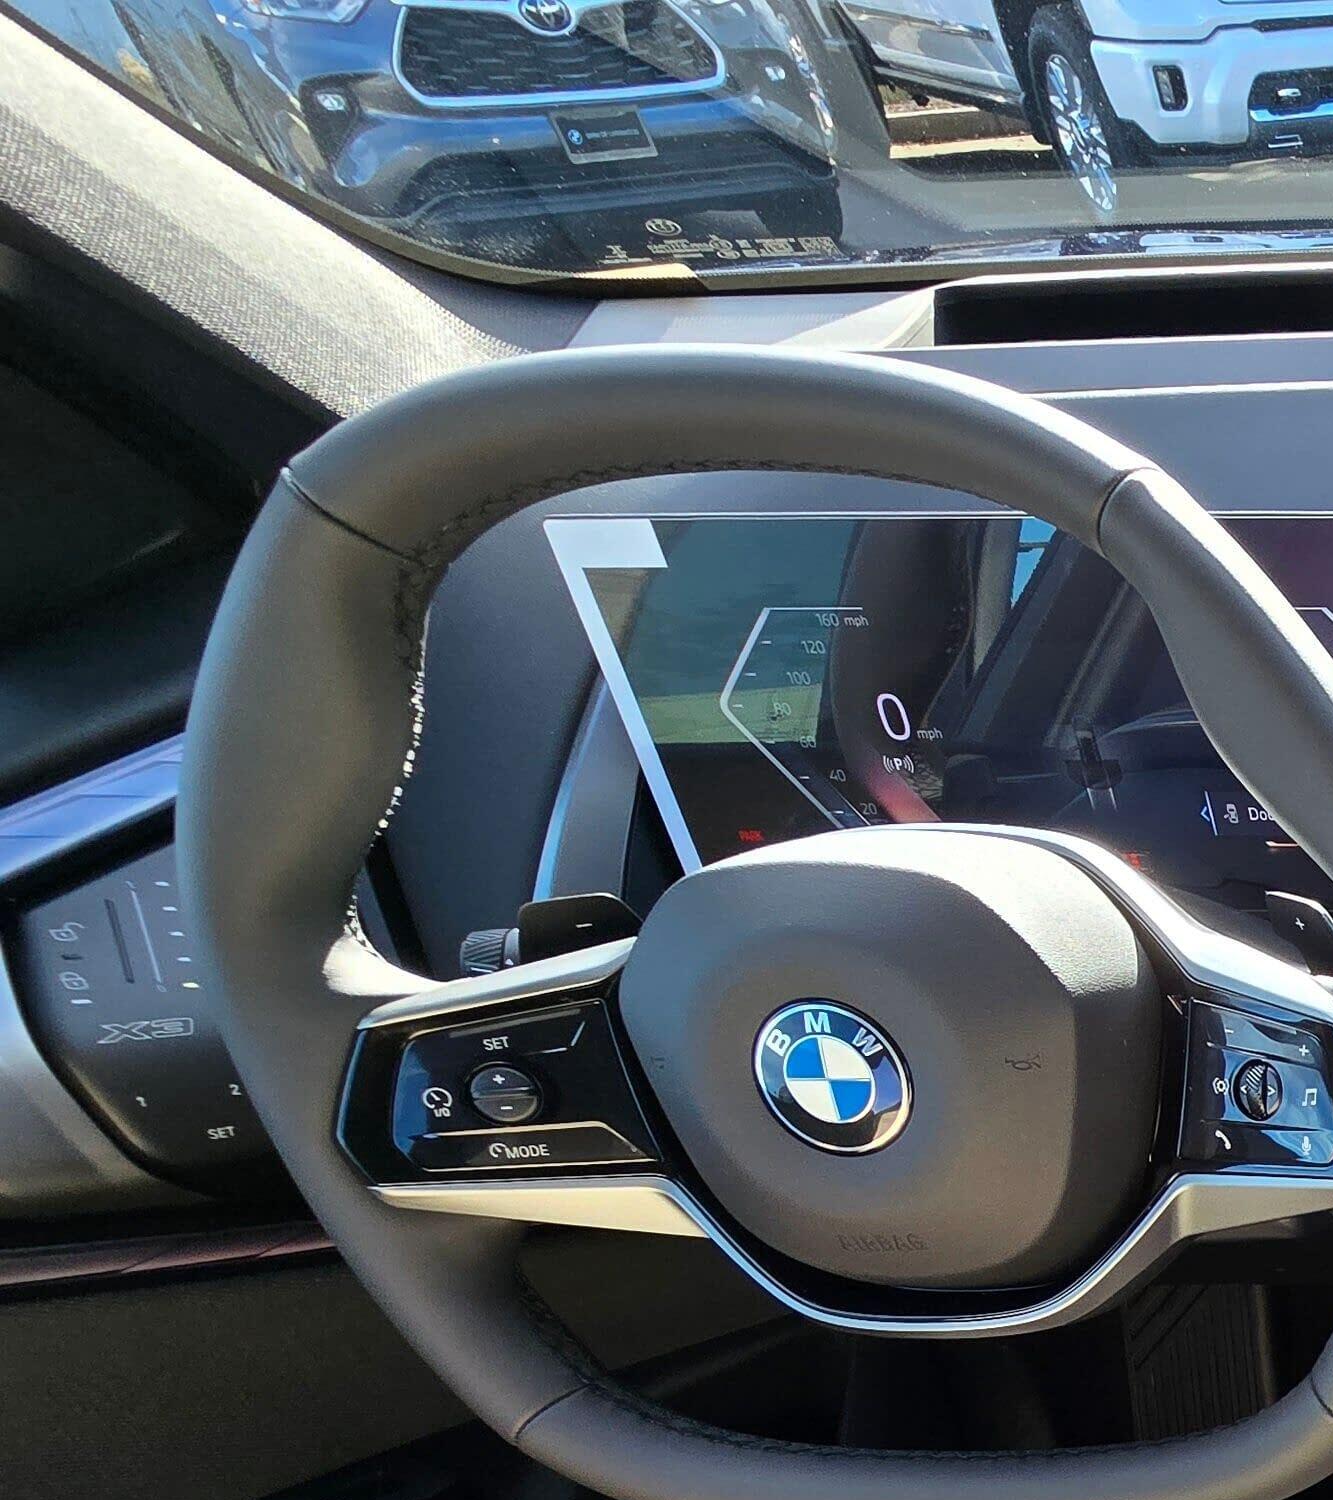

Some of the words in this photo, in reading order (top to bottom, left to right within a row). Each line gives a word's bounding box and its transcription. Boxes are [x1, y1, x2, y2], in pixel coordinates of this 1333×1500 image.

[815, 613, 839, 627] 160
[844, 615, 869, 627] mph
[801, 640, 826, 654] 120
[786, 671, 811, 685] 100
[876, 693, 911, 741] 0
[917, 728, 943, 740] mph
[830, 769, 846, 782] 40
[860, 802, 877, 815] 20
[96, 1018, 195, 1044] X3
[766, 1011, 884, 1057] BMW
[483, 1036, 509, 1051] SET
[229, 1084, 241, 1096] 2
[207, 1126, 236, 1140] SET
[505, 1144, 550, 1159] MODE
